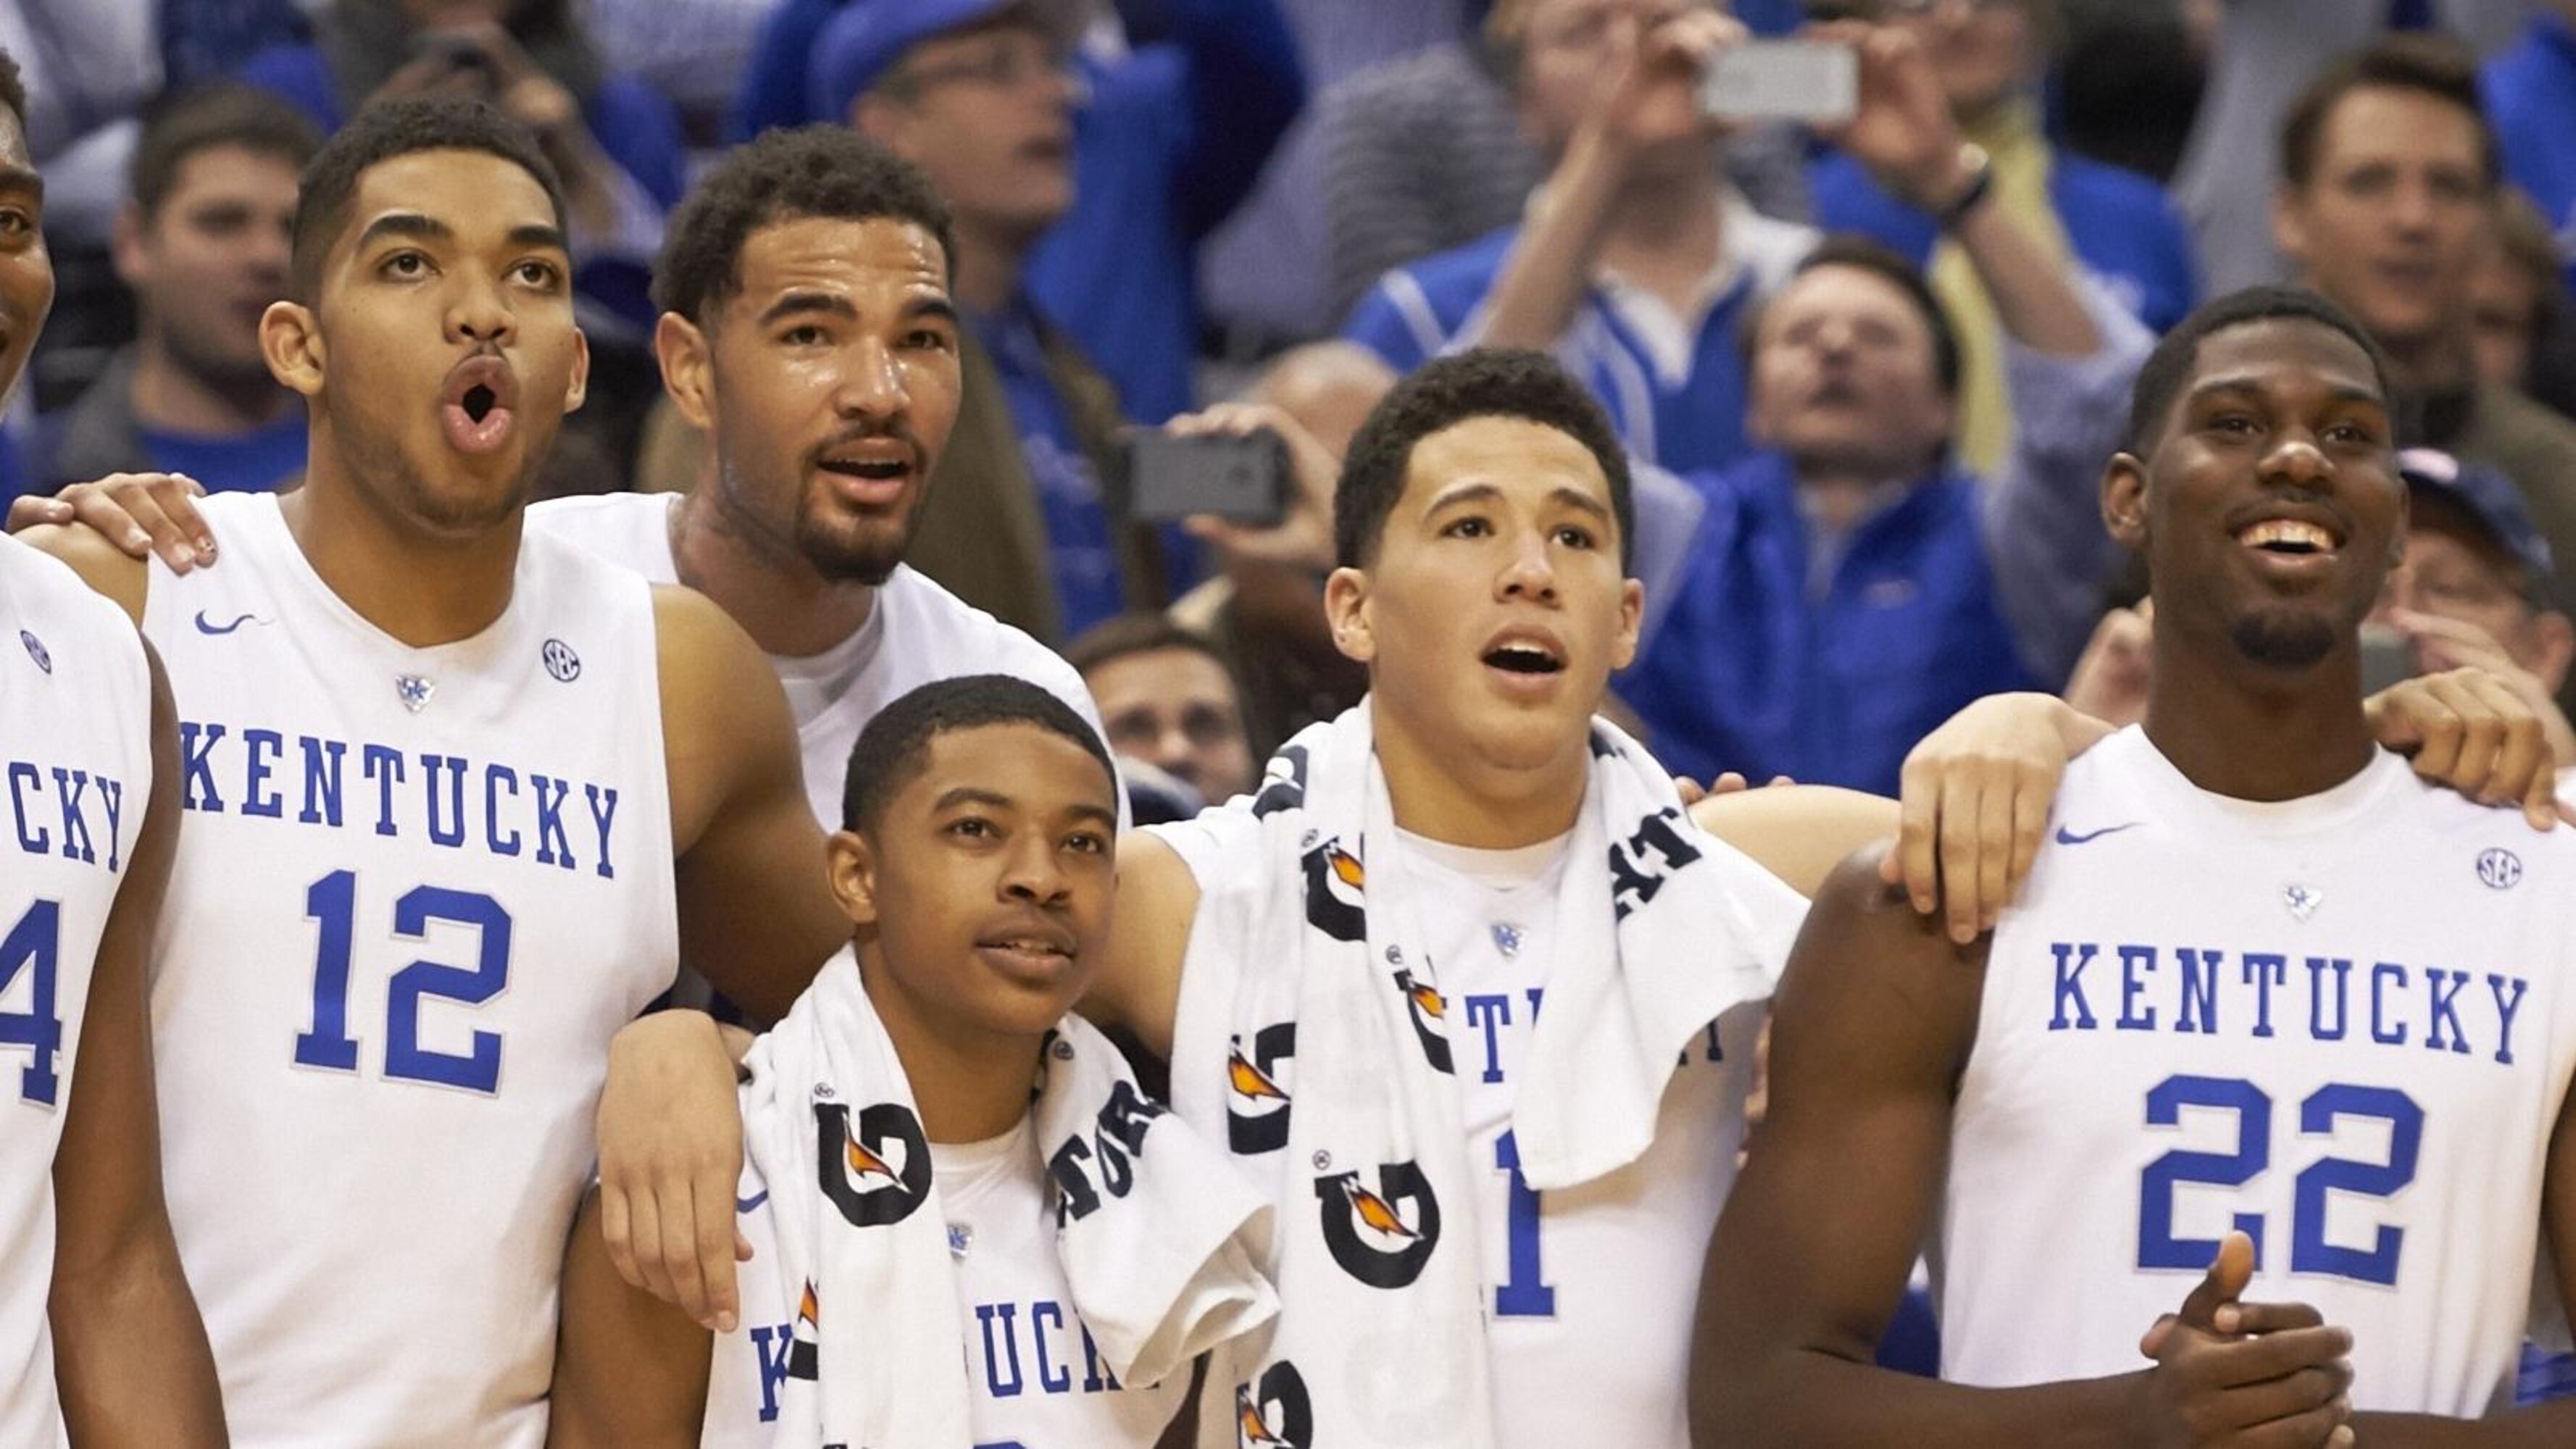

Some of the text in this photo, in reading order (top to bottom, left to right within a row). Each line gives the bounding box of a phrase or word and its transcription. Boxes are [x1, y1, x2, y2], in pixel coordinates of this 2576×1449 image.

[8, 761, 122, 873] CKY
[181, 722, 618, 879] KENTUCKY
[0, 898, 63, 1112] 4
[291, 869, 514, 1098] 12
[2048, 943, 2529, 1066] KENTUCKY
[1494, 1125, 1558, 1320] 1
[2133, 1074, 2426, 1293] 22
